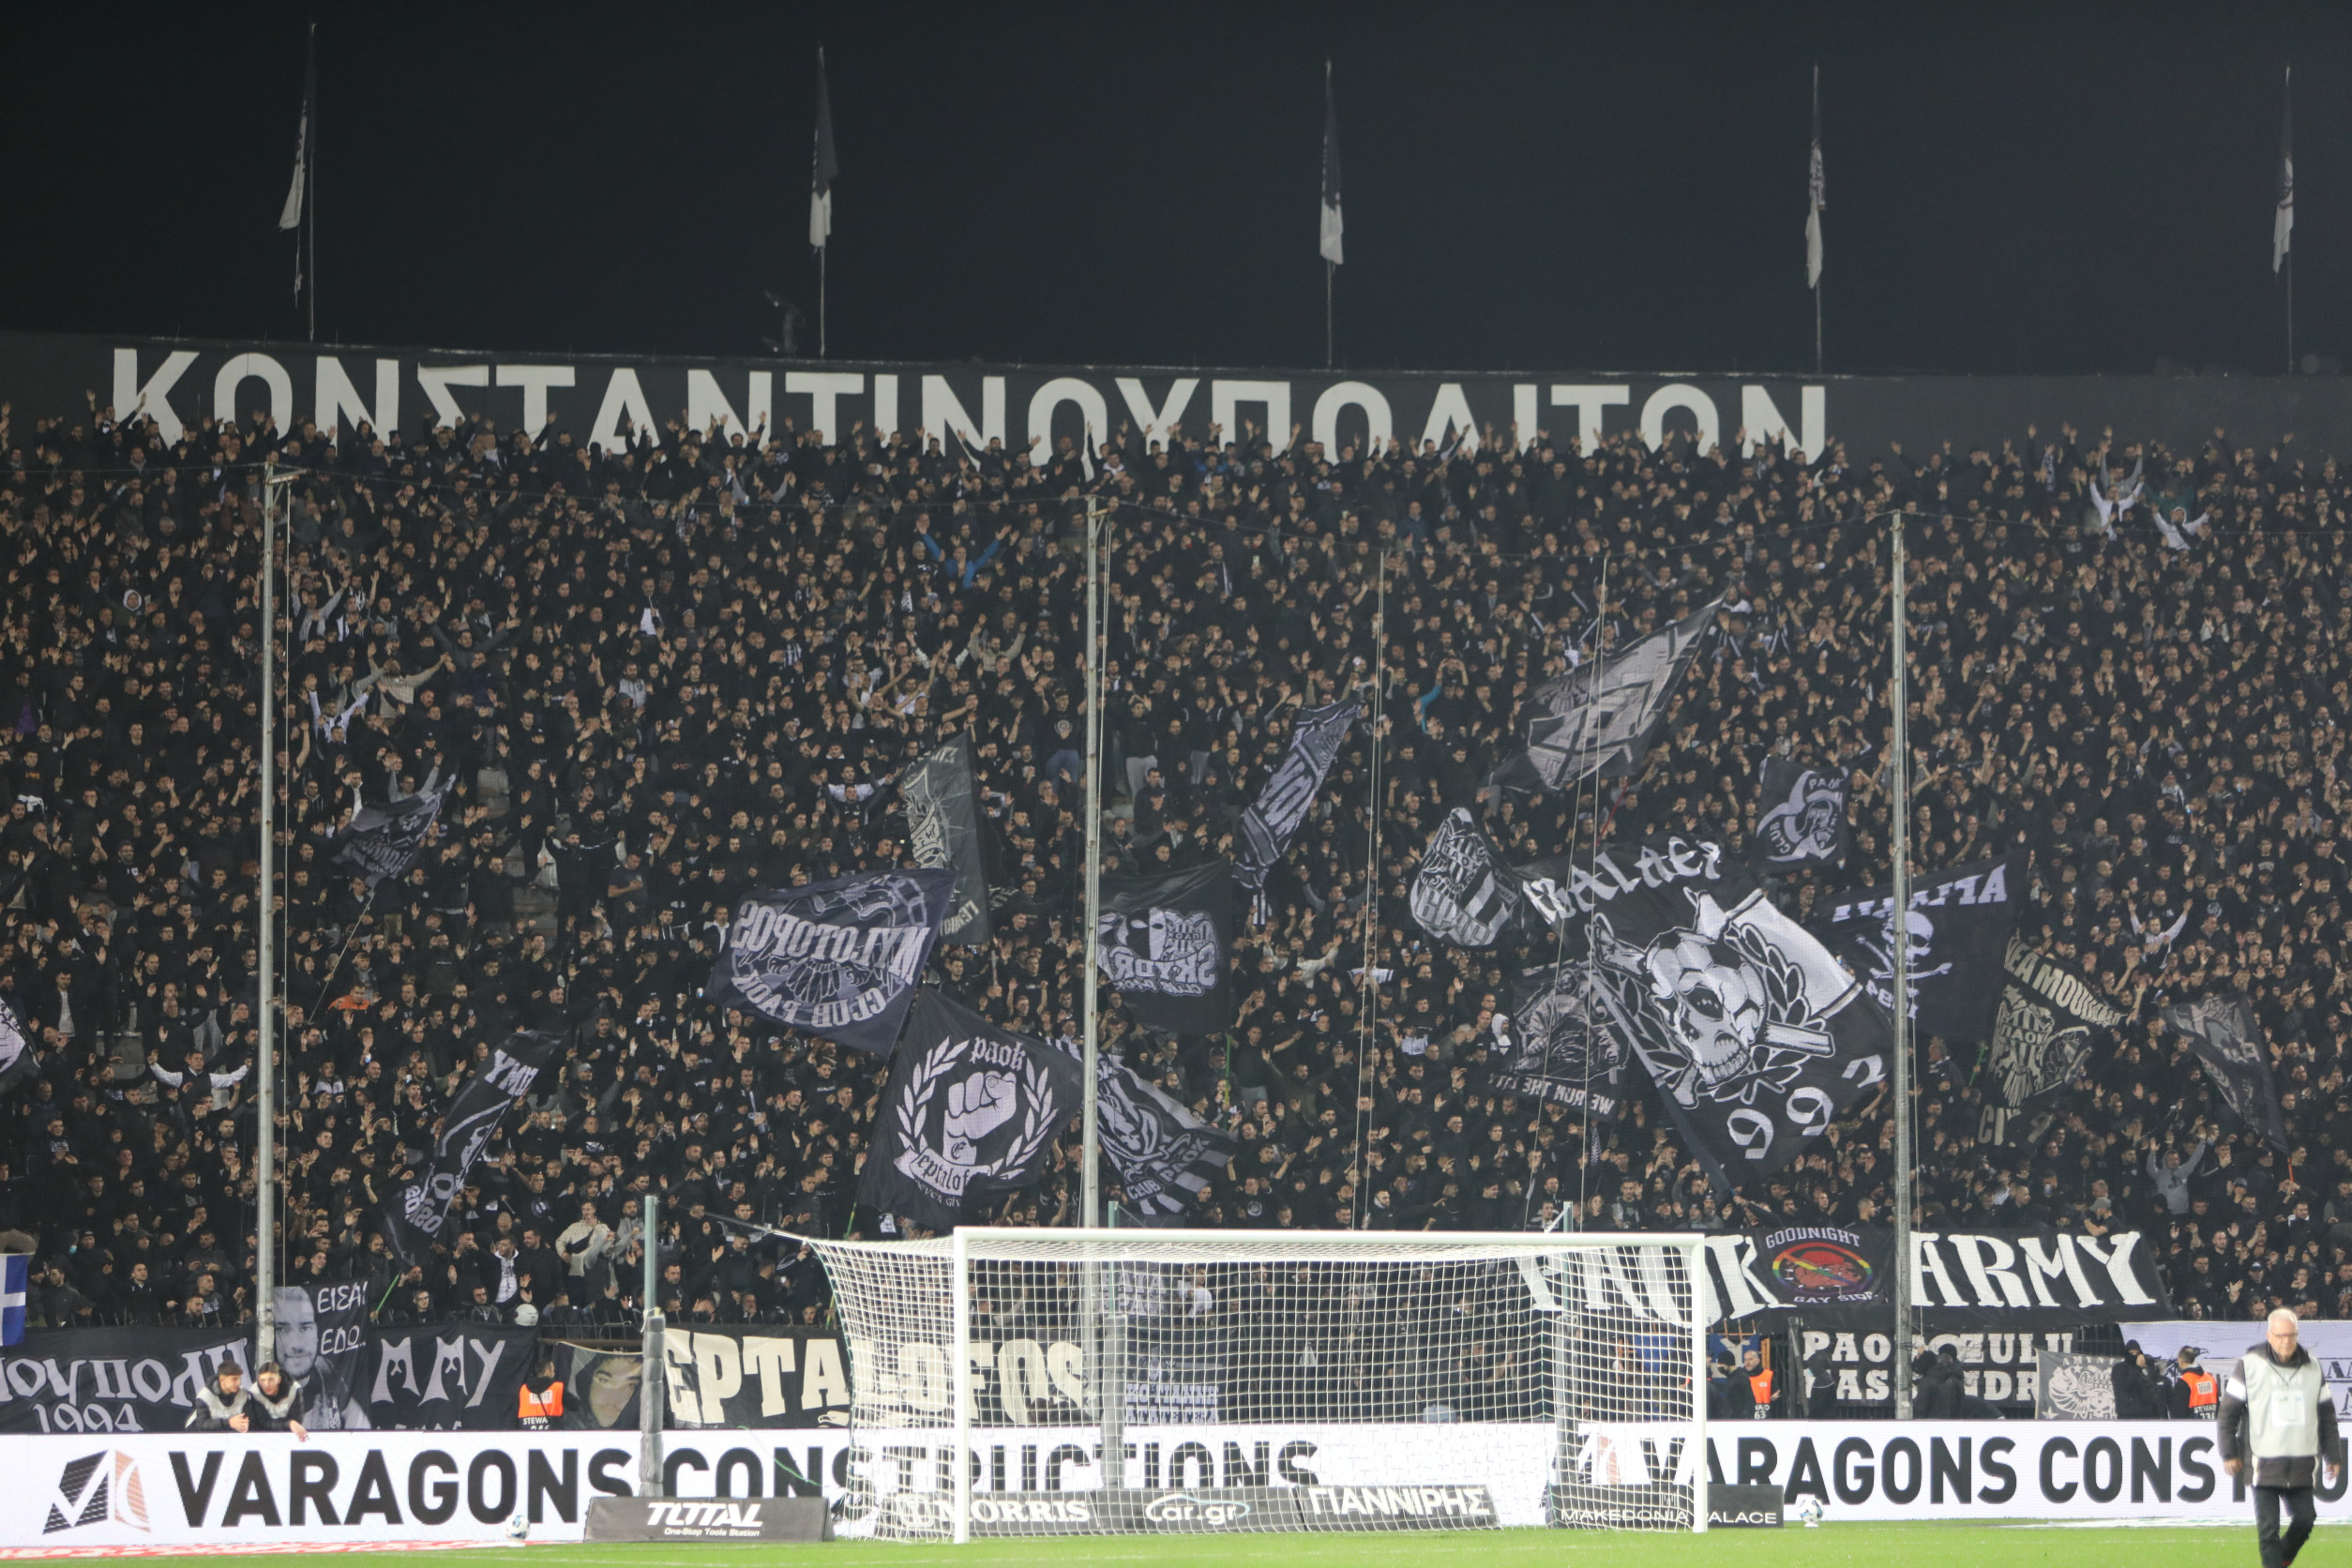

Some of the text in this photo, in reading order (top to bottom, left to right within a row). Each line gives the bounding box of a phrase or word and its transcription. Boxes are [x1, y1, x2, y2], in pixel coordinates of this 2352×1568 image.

[1765, 1227, 1861, 1249] GOODNIGHT
[1910, 1231, 2156, 1308] ARMY
[1793, 1295, 1832, 1304] GAY
[33, 1403, 144, 1433] 1994
[522, 1417, 549, 1425] STEWA
[169, 1447, 639, 1528] VARAGONS
[646, 1502, 764, 1529] TOTAL
[1706, 1511, 1777, 1525] ALACE
[664, 1528, 761, 1537] One-Stop Tools Station
